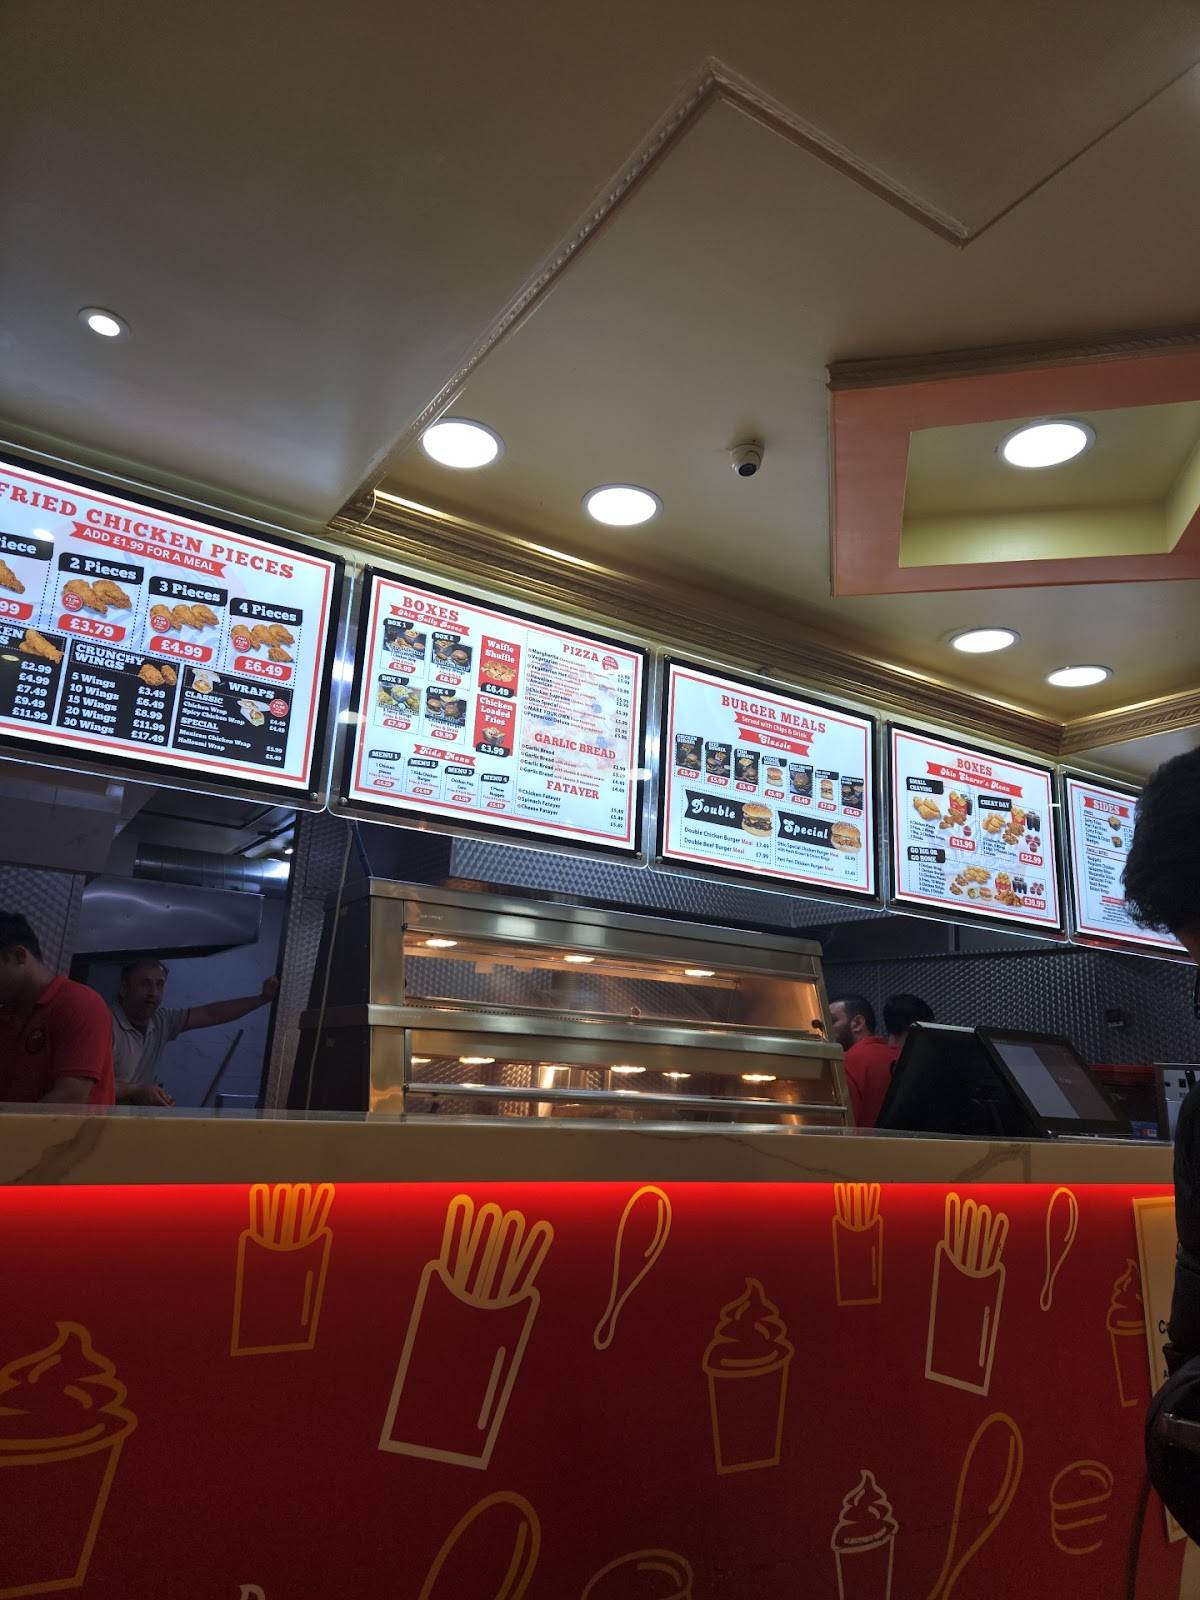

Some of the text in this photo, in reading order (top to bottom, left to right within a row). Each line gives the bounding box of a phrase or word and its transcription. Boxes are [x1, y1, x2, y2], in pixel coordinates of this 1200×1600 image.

[82, 527, 215, 572] ADD £1.99 FOR A MEAL
[86, 509, 203, 553] CHICKEN
[210, 543, 294, 579] PIECES
[69, 557, 137, 580] 2 Pieces
[159, 580, 221, 602] 3 Pieces
[240, 602, 297, 622] 4 Pieces
[402, 596, 460, 622] BOXES
[70, 618, 114, 638] £3.79
[76, 643, 145, 666] CRUNCHY
[161, 639, 203, 658] £4.99
[487, 640, 514, 653] Waffle
[563, 644, 599, 662] PIZZA
[75, 651, 125, 671] WINGS
[484, 649, 516, 664] Shuffle
[21, 660, 52, 674] £2.99
[244, 659, 283, 677] £6.49
[19, 672, 50, 686] £4.99
[72, 672, 166, 698] 5 Wings £3.49
[16, 684, 48, 696] £7.49
[70, 683, 164, 710] 10 Wings £6.49
[184, 690, 224, 704] CLASSIC
[228, 682, 275, 700] WRAPS
[486, 684, 510, 696] £6.49
[14, 695, 46, 708] £9.49
[68, 694, 80, 704] 15
[82, 697, 118, 712] Wings
[183, 700, 210, 711] Chicken
[210, 706, 228, 716] Wrap
[480, 696, 512, 710] Chicken
[12, 706, 48, 720] £11.99
[66, 706, 166, 732] 20 Wings £11.99
[182, 708, 201, 717] Spicy
[201, 711, 228, 721] Chicken
[228, 716, 245, 726] Wrap
[480, 705, 510, 718] Loaded
[721, 694, 826, 733] BURGER MEALS
[180, 716, 219, 730] SPECIAL
[484, 714, 506, 726] Fries
[741, 716, 760, 726] Served
[760, 721, 773, 729] with
[64, 717, 164, 743] 30 Wings £17.49
[178, 736, 207, 748] Halloumi
[208, 742, 226, 752] Wrap
[179, 729, 208, 739] Mexican
[208, 734, 234, 745] Chicken
[234, 740, 252, 748] Wrap
[534, 732, 616, 760] GARLIC BREAD
[758, 734, 792, 750] Classic
[372, 750, 392, 759] MENU
[419, 746, 442, 758] Kids
[481, 744, 504, 756] £3.99
[541, 747, 555, 756] Bread
[410, 759, 430, 767] MENU
[540, 762, 554, 770] Bread
[957, 758, 992, 777] BOXES
[522, 789, 542, 797] Chicken
[546, 780, 600, 800] FATAYER
[691, 798, 736, 819] Double
[1093, 799, 1120, 815] SIDES
[684, 826, 702, 836] Double
[704, 831, 724, 840] Chicken
[724, 835, 741, 843] Burger
[783, 818, 828, 839] Special
[684, 837, 702, 846] Double
[715, 843, 732, 852] Burger
[951, 838, 973, 849] £11.99
[1021, 853, 1042, 864] £22.99
